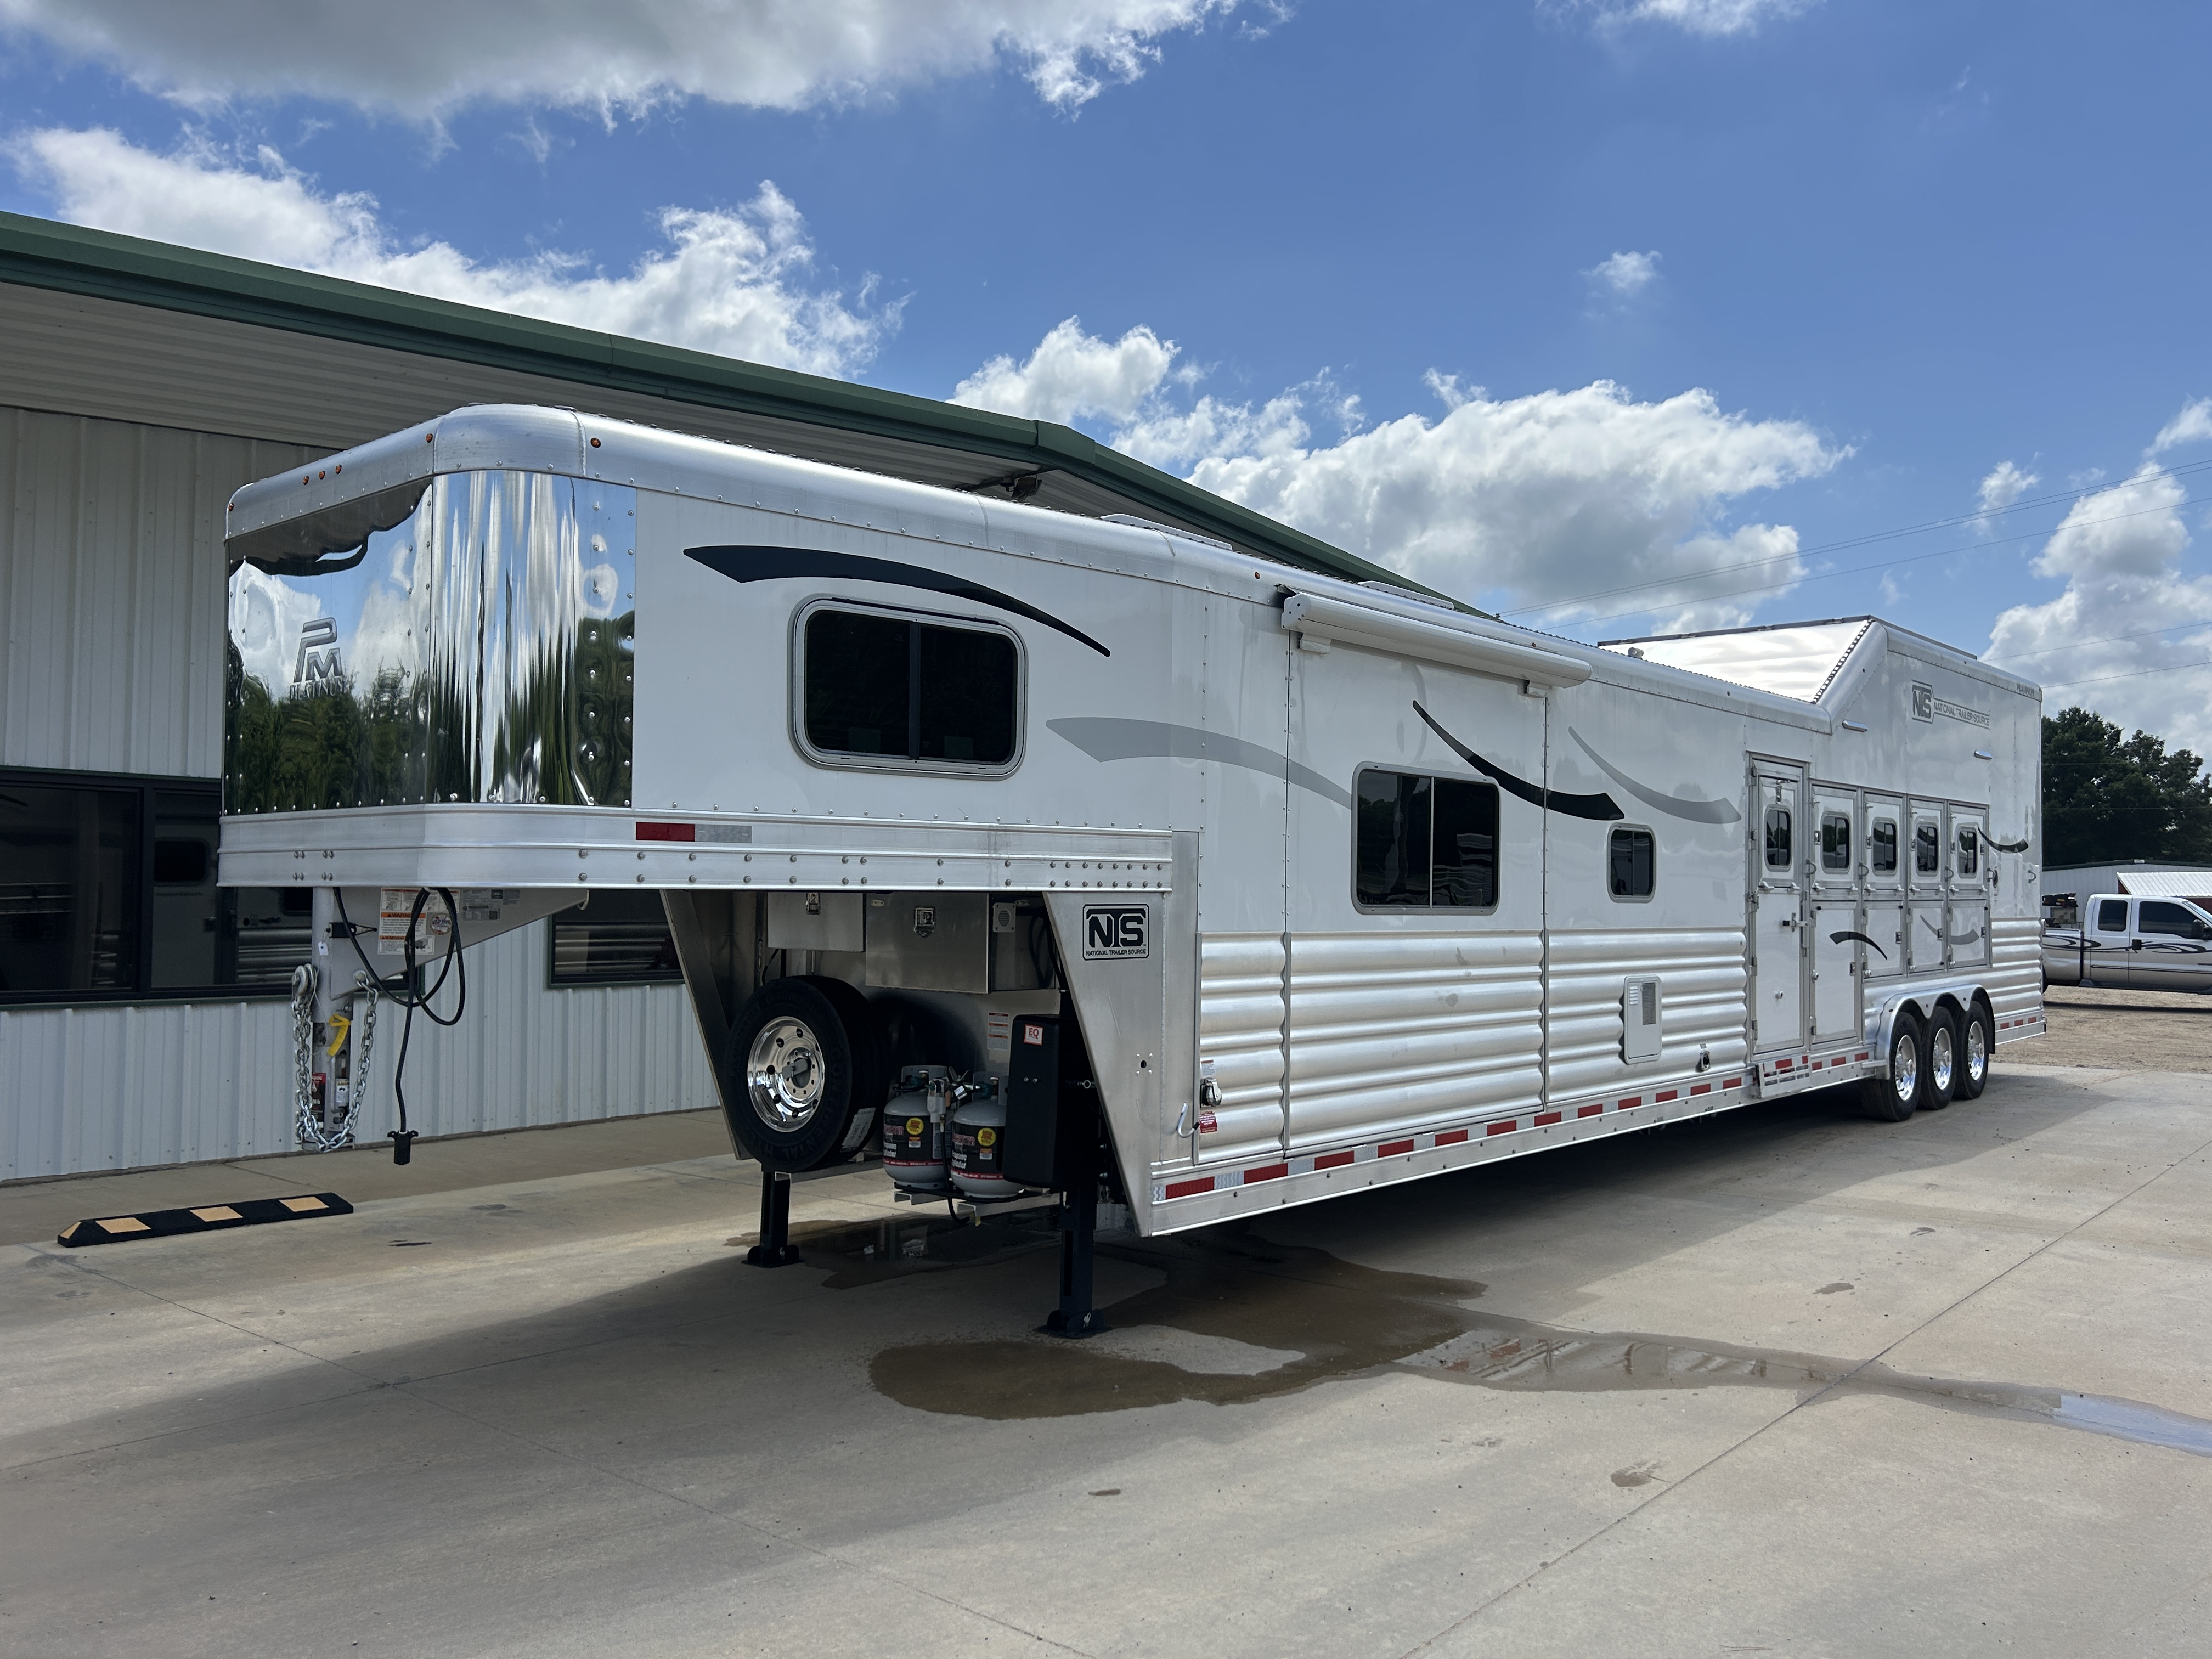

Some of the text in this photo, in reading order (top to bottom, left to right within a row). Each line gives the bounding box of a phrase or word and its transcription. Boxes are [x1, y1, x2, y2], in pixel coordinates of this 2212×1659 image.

[290, 678, 347, 701] PLATINUM
[1912, 685, 1990, 727] NTS NATIONAL TRAILER SOURCE
[1086, 909, 1147, 948] NTS
[1029, 1028, 1039, 1039] EQ
